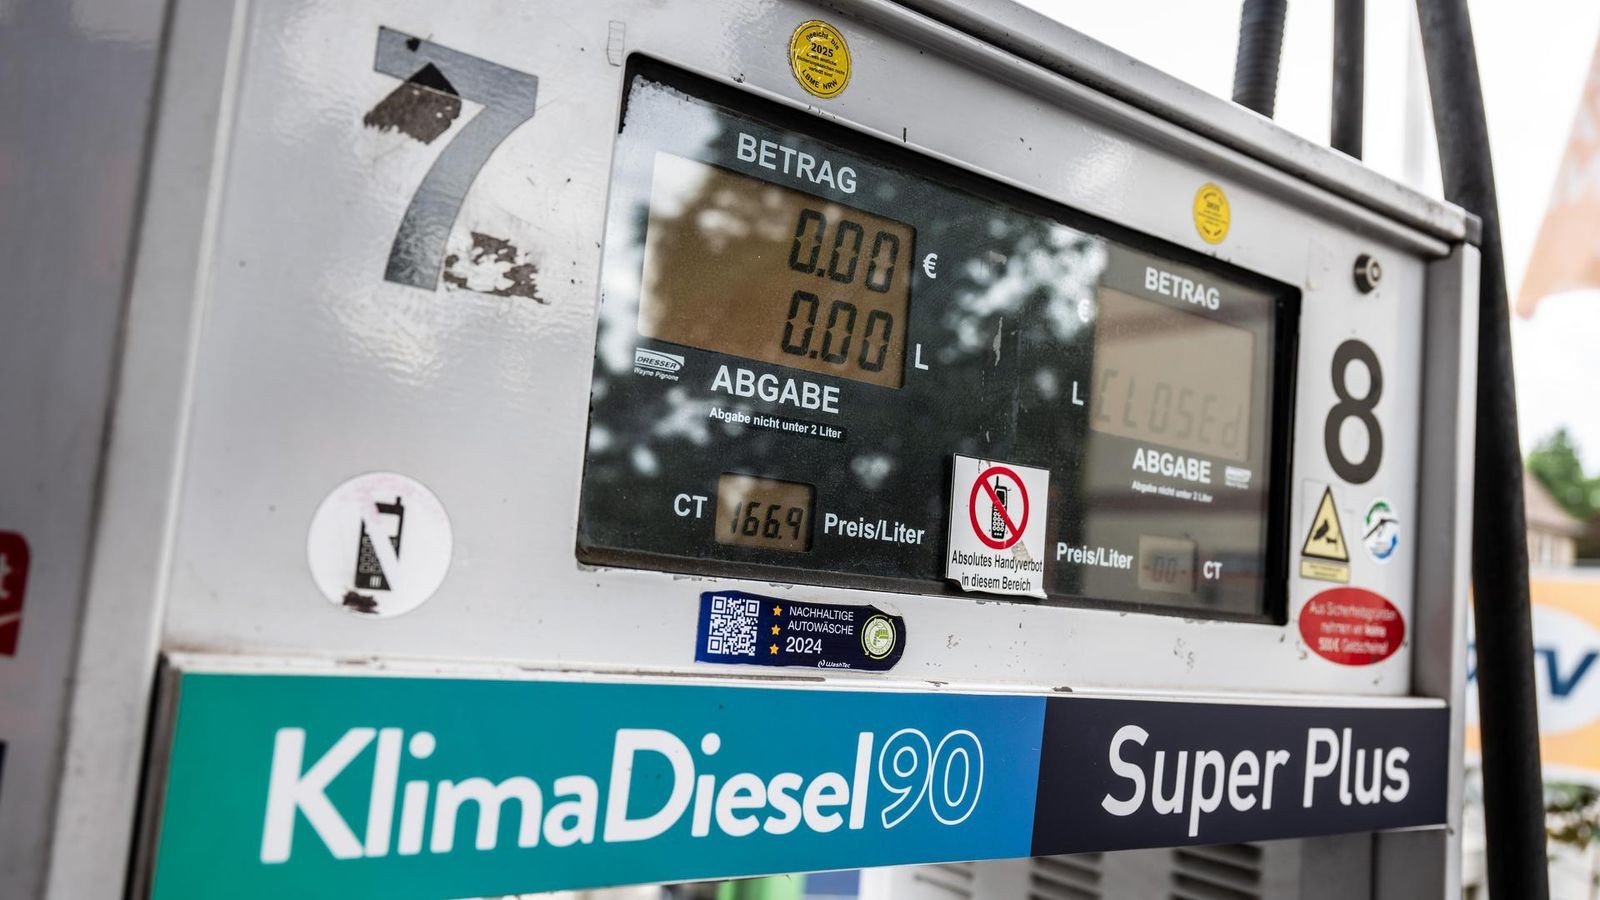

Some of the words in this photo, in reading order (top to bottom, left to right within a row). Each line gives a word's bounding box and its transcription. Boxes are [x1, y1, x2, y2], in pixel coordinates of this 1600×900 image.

[811, 42, 834, 58] 2025
[831, 38, 839, 50] bis
[802, 69, 820, 89] LBME
[823, 79, 838, 90] NRW
[373, 25, 539, 292] 7
[737, 132, 858, 194] BETRAG
[787, 208, 900, 294] 0.00
[922, 253, 938, 279] €
[1144, 266, 1221, 311] BETRAG
[780, 289, 894, 373] 0.00
[636, 356, 678, 369] DRESSER
[914, 343, 929, 371] L
[710, 364, 841, 415] ABGABE
[1071, 380, 1084, 406] L
[709, 407, 751, 424] Abgabe
[753, 416, 780, 429] nicht
[782, 421, 809, 434] unter
[810, 424, 818, 435] 2
[819, 426, 842, 439] Liter
[1324, 339, 1384, 485] 8
[1132, 447, 1213, 485] ABGABE
[673, 493, 708, 519] CT
[824, 512, 926, 545] Preis/Liter
[951, 549, 992, 568] Absolutes
[994, 554, 1042, 574] Handyverbot
[1056, 541, 1135, 570] Preis/Liter
[961, 571, 969, 586] in
[971, 573, 1000, 590] diesem
[1002, 576, 1031, 592] Bereich
[1203, 560, 1223, 580] CT
[789, 605, 854, 622] NACHHALTIGE
[787, 619, 854, 636] AUTOWÄSCHE
[785, 636, 823, 655] 2024
[1101, 724, 1291, 838] Super
[1303, 727, 1411, 808] Plus
